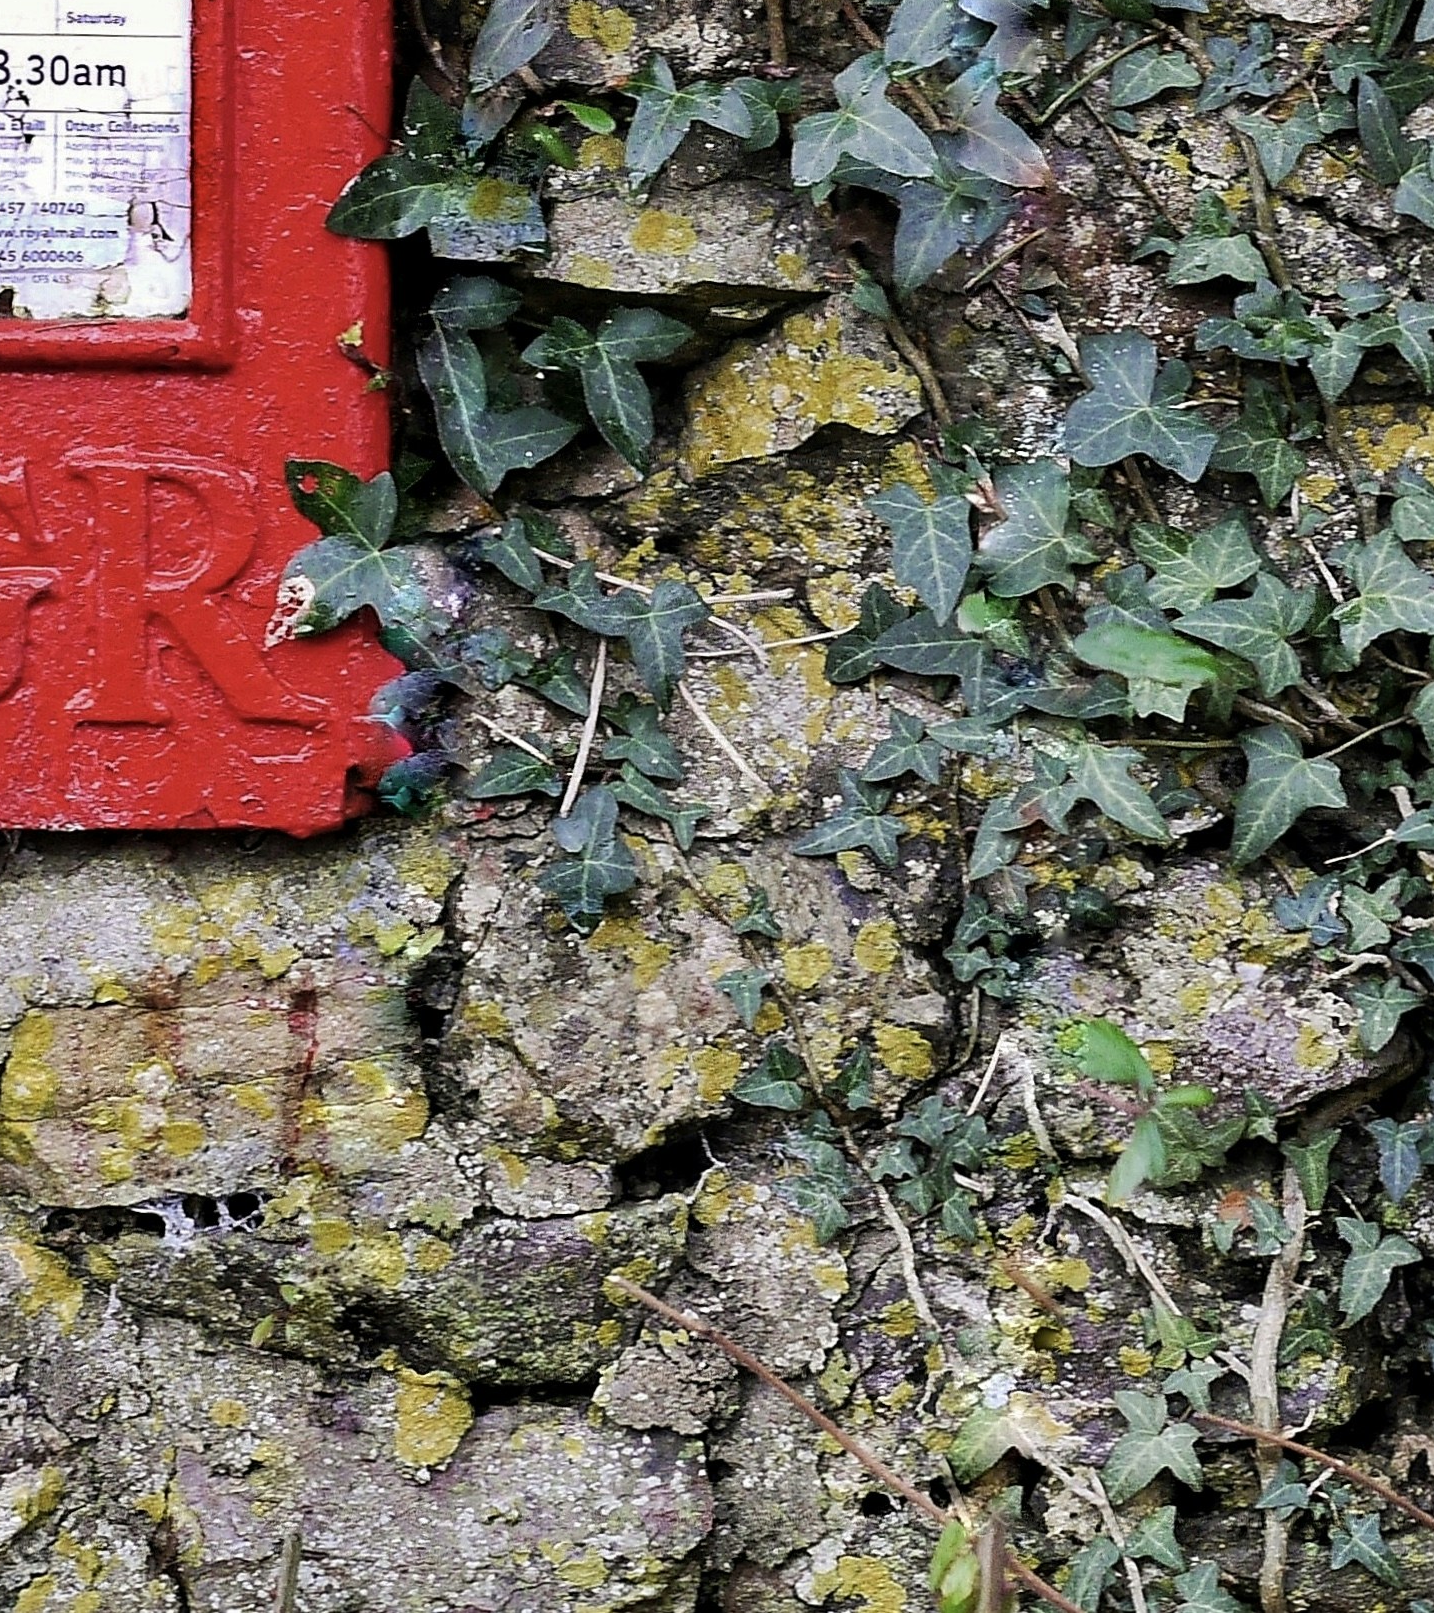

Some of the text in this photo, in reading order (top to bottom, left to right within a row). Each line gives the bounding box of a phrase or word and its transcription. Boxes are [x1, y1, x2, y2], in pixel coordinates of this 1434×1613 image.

[66, 11, 127, 26] Saturday
[66, 120, 180, 133] Other Collections
[21, 250, 84, 263] 6000606
